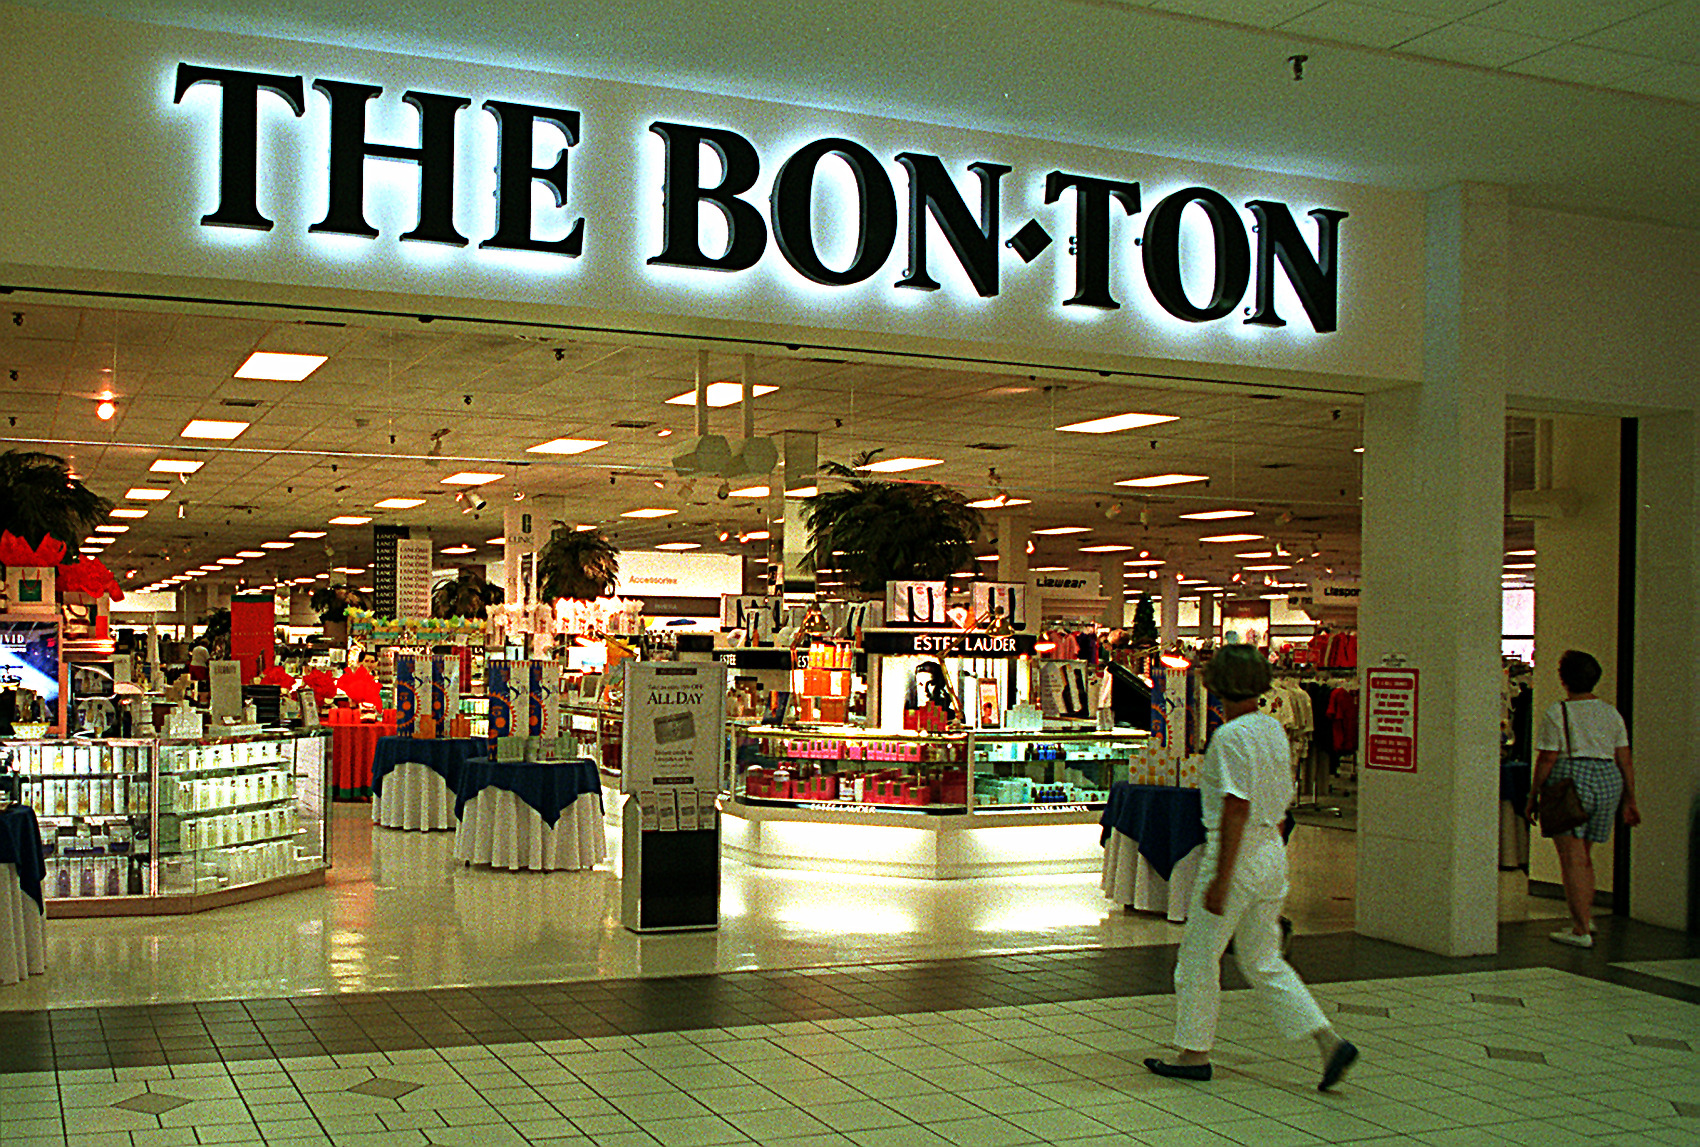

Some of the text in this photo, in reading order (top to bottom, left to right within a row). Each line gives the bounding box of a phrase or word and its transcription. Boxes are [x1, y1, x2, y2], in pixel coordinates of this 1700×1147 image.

[173, 62, 585, 258] THE
[628, 574, 678, 585] Accessories
[1036, 577, 1087, 588] Lizwear
[1324, 586, 1361, 597] Lizspor
[964, 637, 1017, 652] LAUDER
[647, 691, 704, 705] ALL DAY
